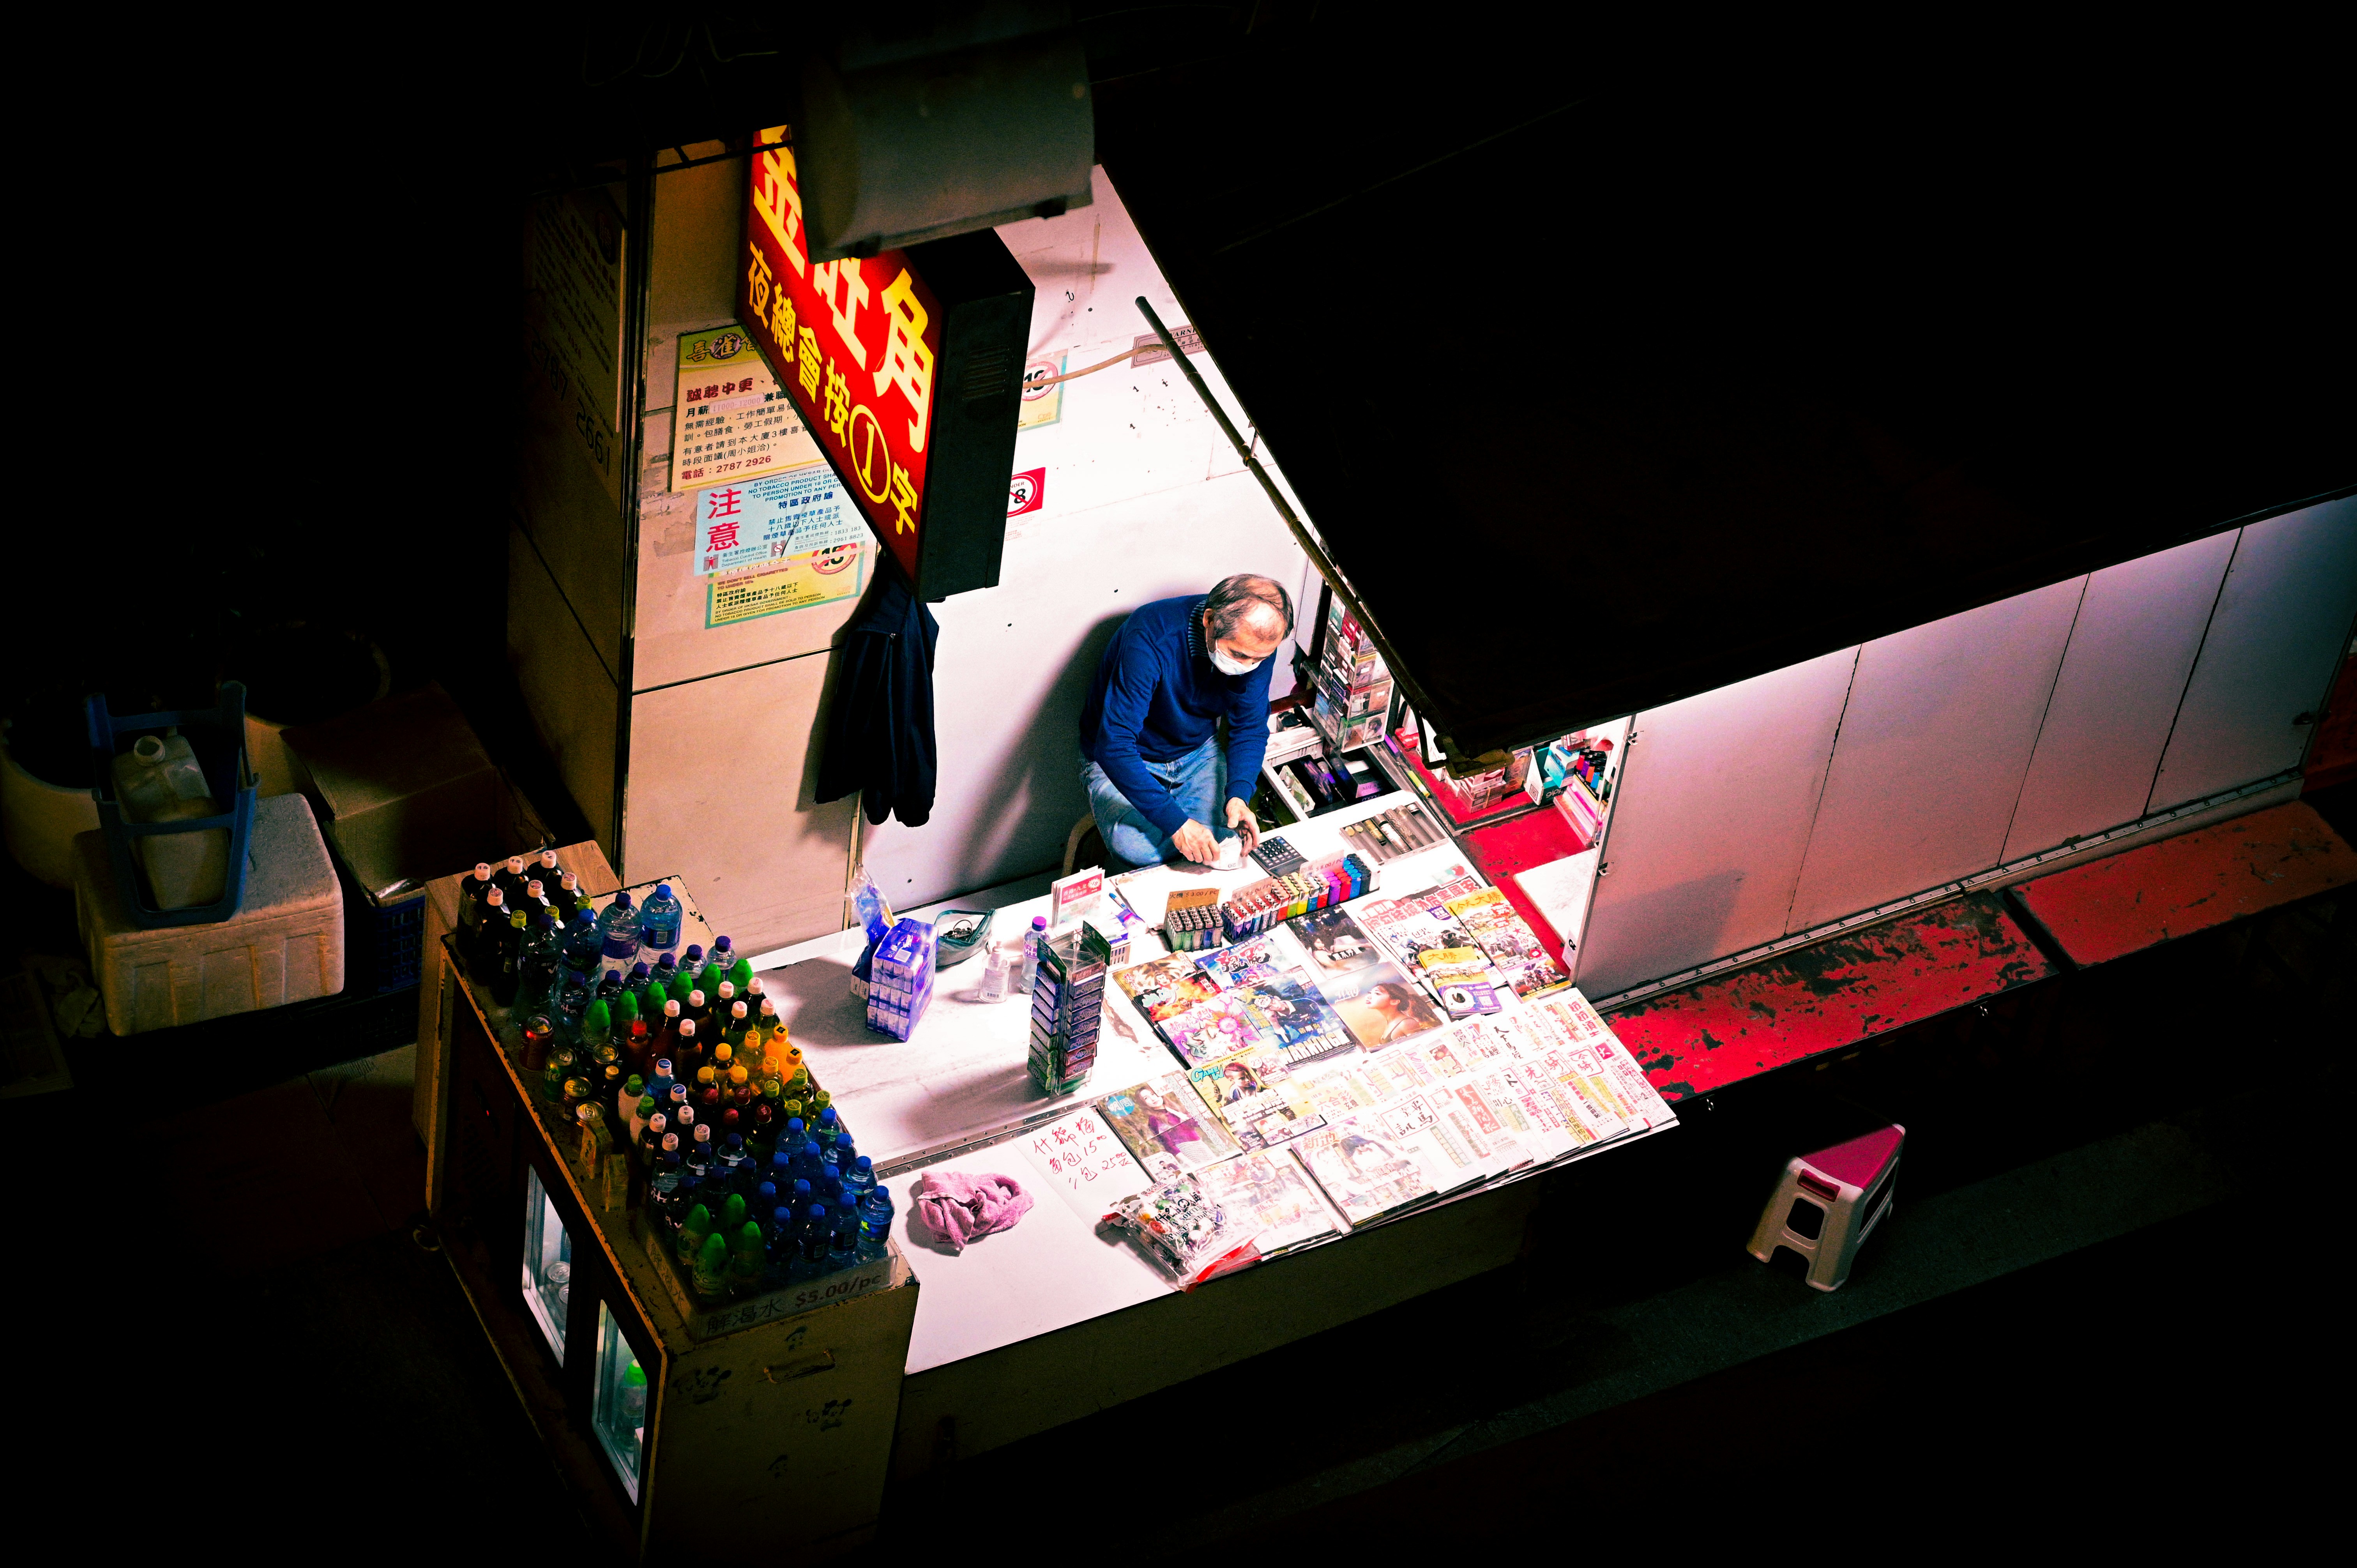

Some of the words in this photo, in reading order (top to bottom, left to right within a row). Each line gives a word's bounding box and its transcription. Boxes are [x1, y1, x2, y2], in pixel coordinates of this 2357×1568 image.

[687, 377, 777, 403] 誠聘中更、
[686, 405, 709, 418] 月薪
[716, 461, 742, 473] 2787
[745, 456, 771, 467] 2926
[759, 482, 789, 492] TOBACCO
[791, 475, 821, 485] PRODUCT
[763, 488, 789, 498] PERSON
[765, 491, 802, 502] PROMOTION
[706, 488, 742, 553] 注意
[795, 1273, 881, 1308] $5.00/pc
